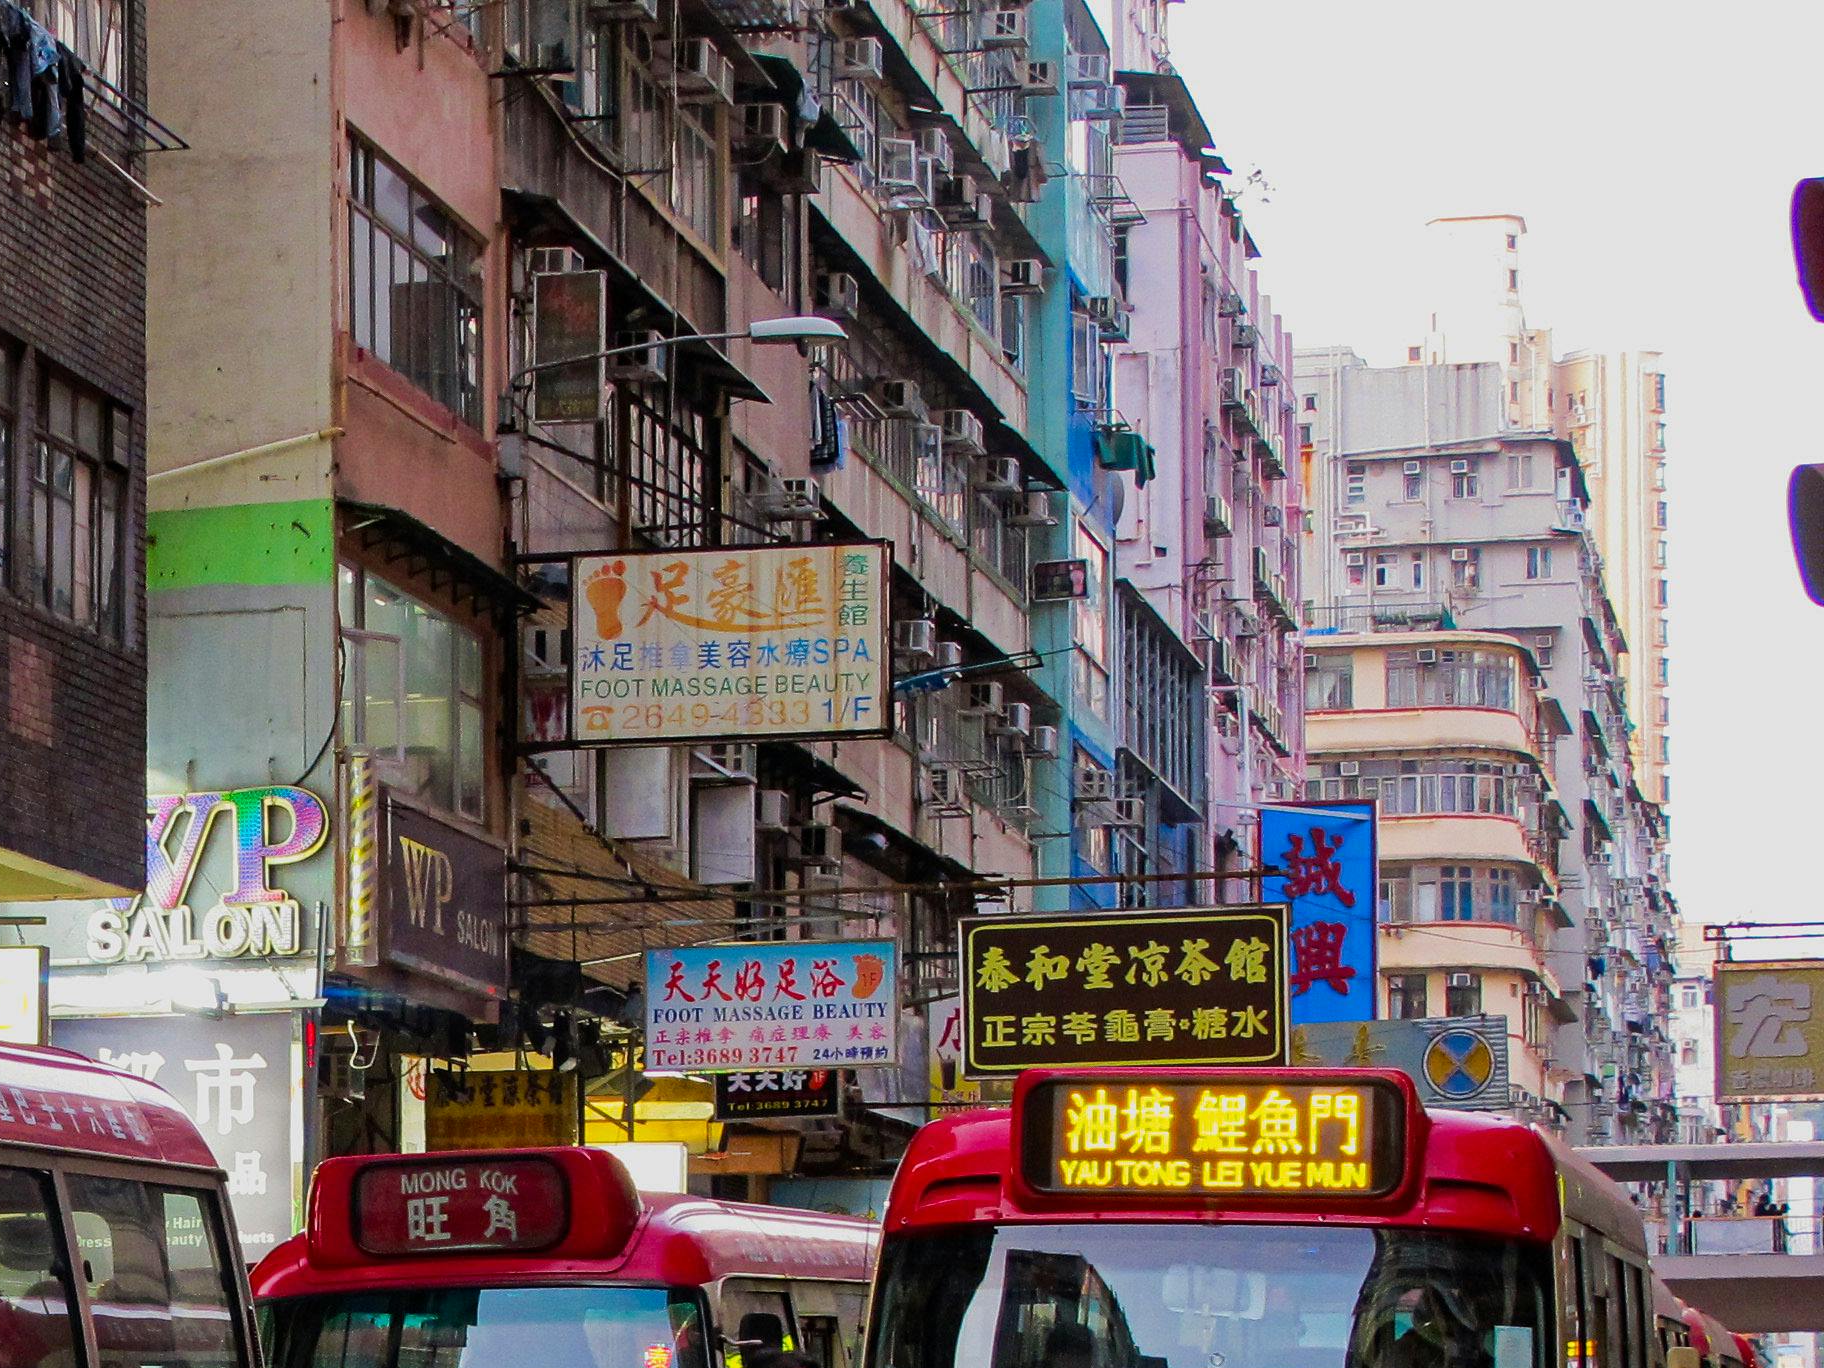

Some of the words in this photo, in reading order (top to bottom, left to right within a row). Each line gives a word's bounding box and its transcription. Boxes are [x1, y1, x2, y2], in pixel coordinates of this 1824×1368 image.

[581, 679, 645, 699] FOOT
[651, 674, 768, 697] MASSAGE
[776, 672, 872, 694] BEAUTY
[821, 696, 873, 723] 1/F
[399, 836, 453, 936] WP
[1280, 827, 1357, 997] 誠興
[87, 898, 300, 962] SALON
[456, 909, 499, 957] SALON
[663, 958, 845, 1002] 天天好足浴
[653, 1007, 705, 1024] FOOT
[713, 1004, 804, 1023] MASSAGE
[812, 1001, 889, 1020] BEAUTY
[653, 1026, 736, 1045] 正宗推拿
[845, 1022, 889, 1041] 美容
[653, 1046, 744, 1067] Tel:3689
[749, 1046, 800, 1064] 3747
[793, 1099, 829, 1109] 3747
[1066, 1088, 1174, 1155] 油塘
[1192, 1088, 1360, 1155] 鯉魚門
[400, 1168, 468, 1196] MONG
[479, 1169, 519, 1196] KOK
[1061, 1160, 1114, 1188] YAU
[1114, 1160, 1192, 1188] TONG
[1202, 1160, 1245, 1188] LEI
[1249, 1160, 1303, 1189] YUE
[1305, 1161, 1368, 1190] MUN
[406, 1194, 518, 1242] 旺角
